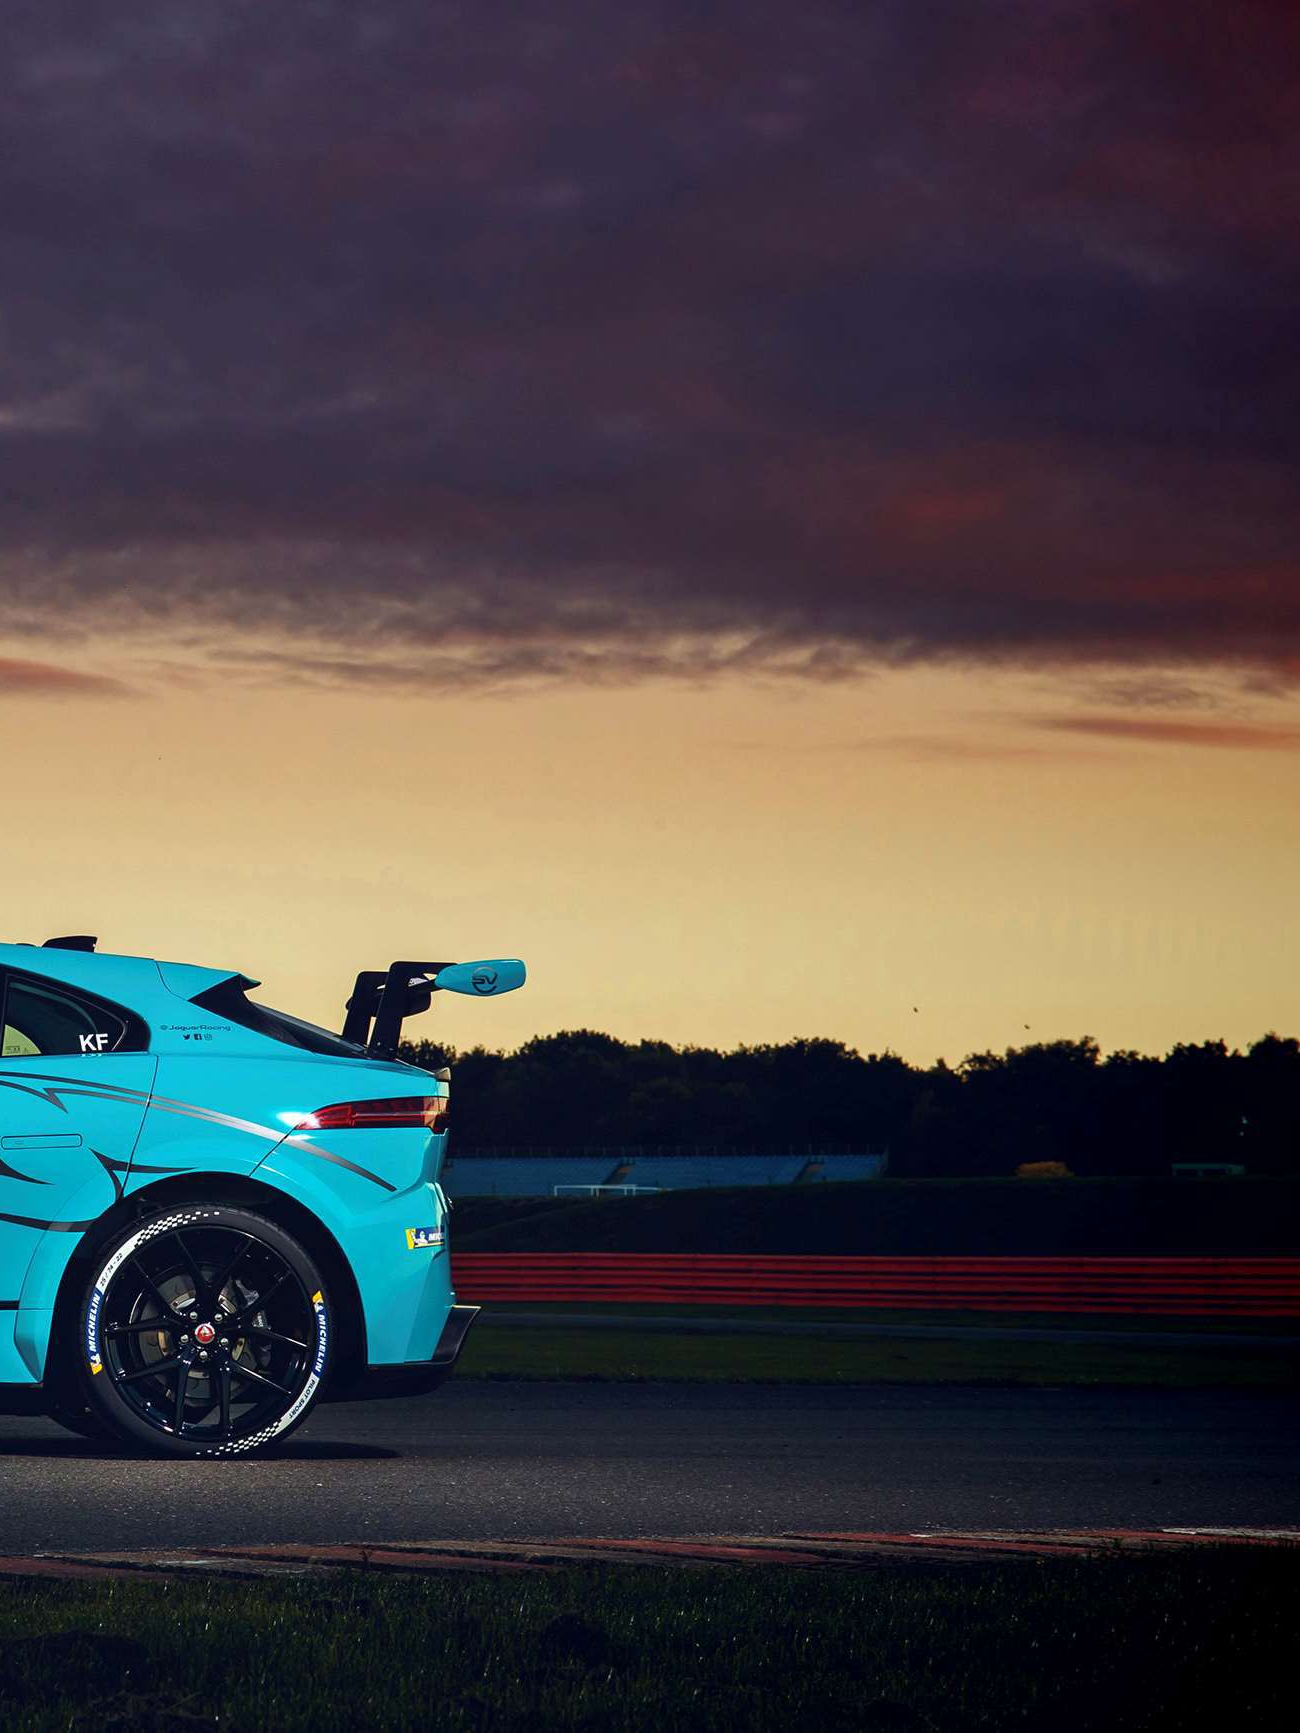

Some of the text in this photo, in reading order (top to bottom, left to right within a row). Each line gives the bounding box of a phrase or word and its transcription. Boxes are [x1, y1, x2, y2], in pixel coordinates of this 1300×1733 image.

[79, 1033, 109, 1052] KF
[88, 1293, 100, 1352] MICHELIN
[315, 1313, 327, 1373] MICHELIN
